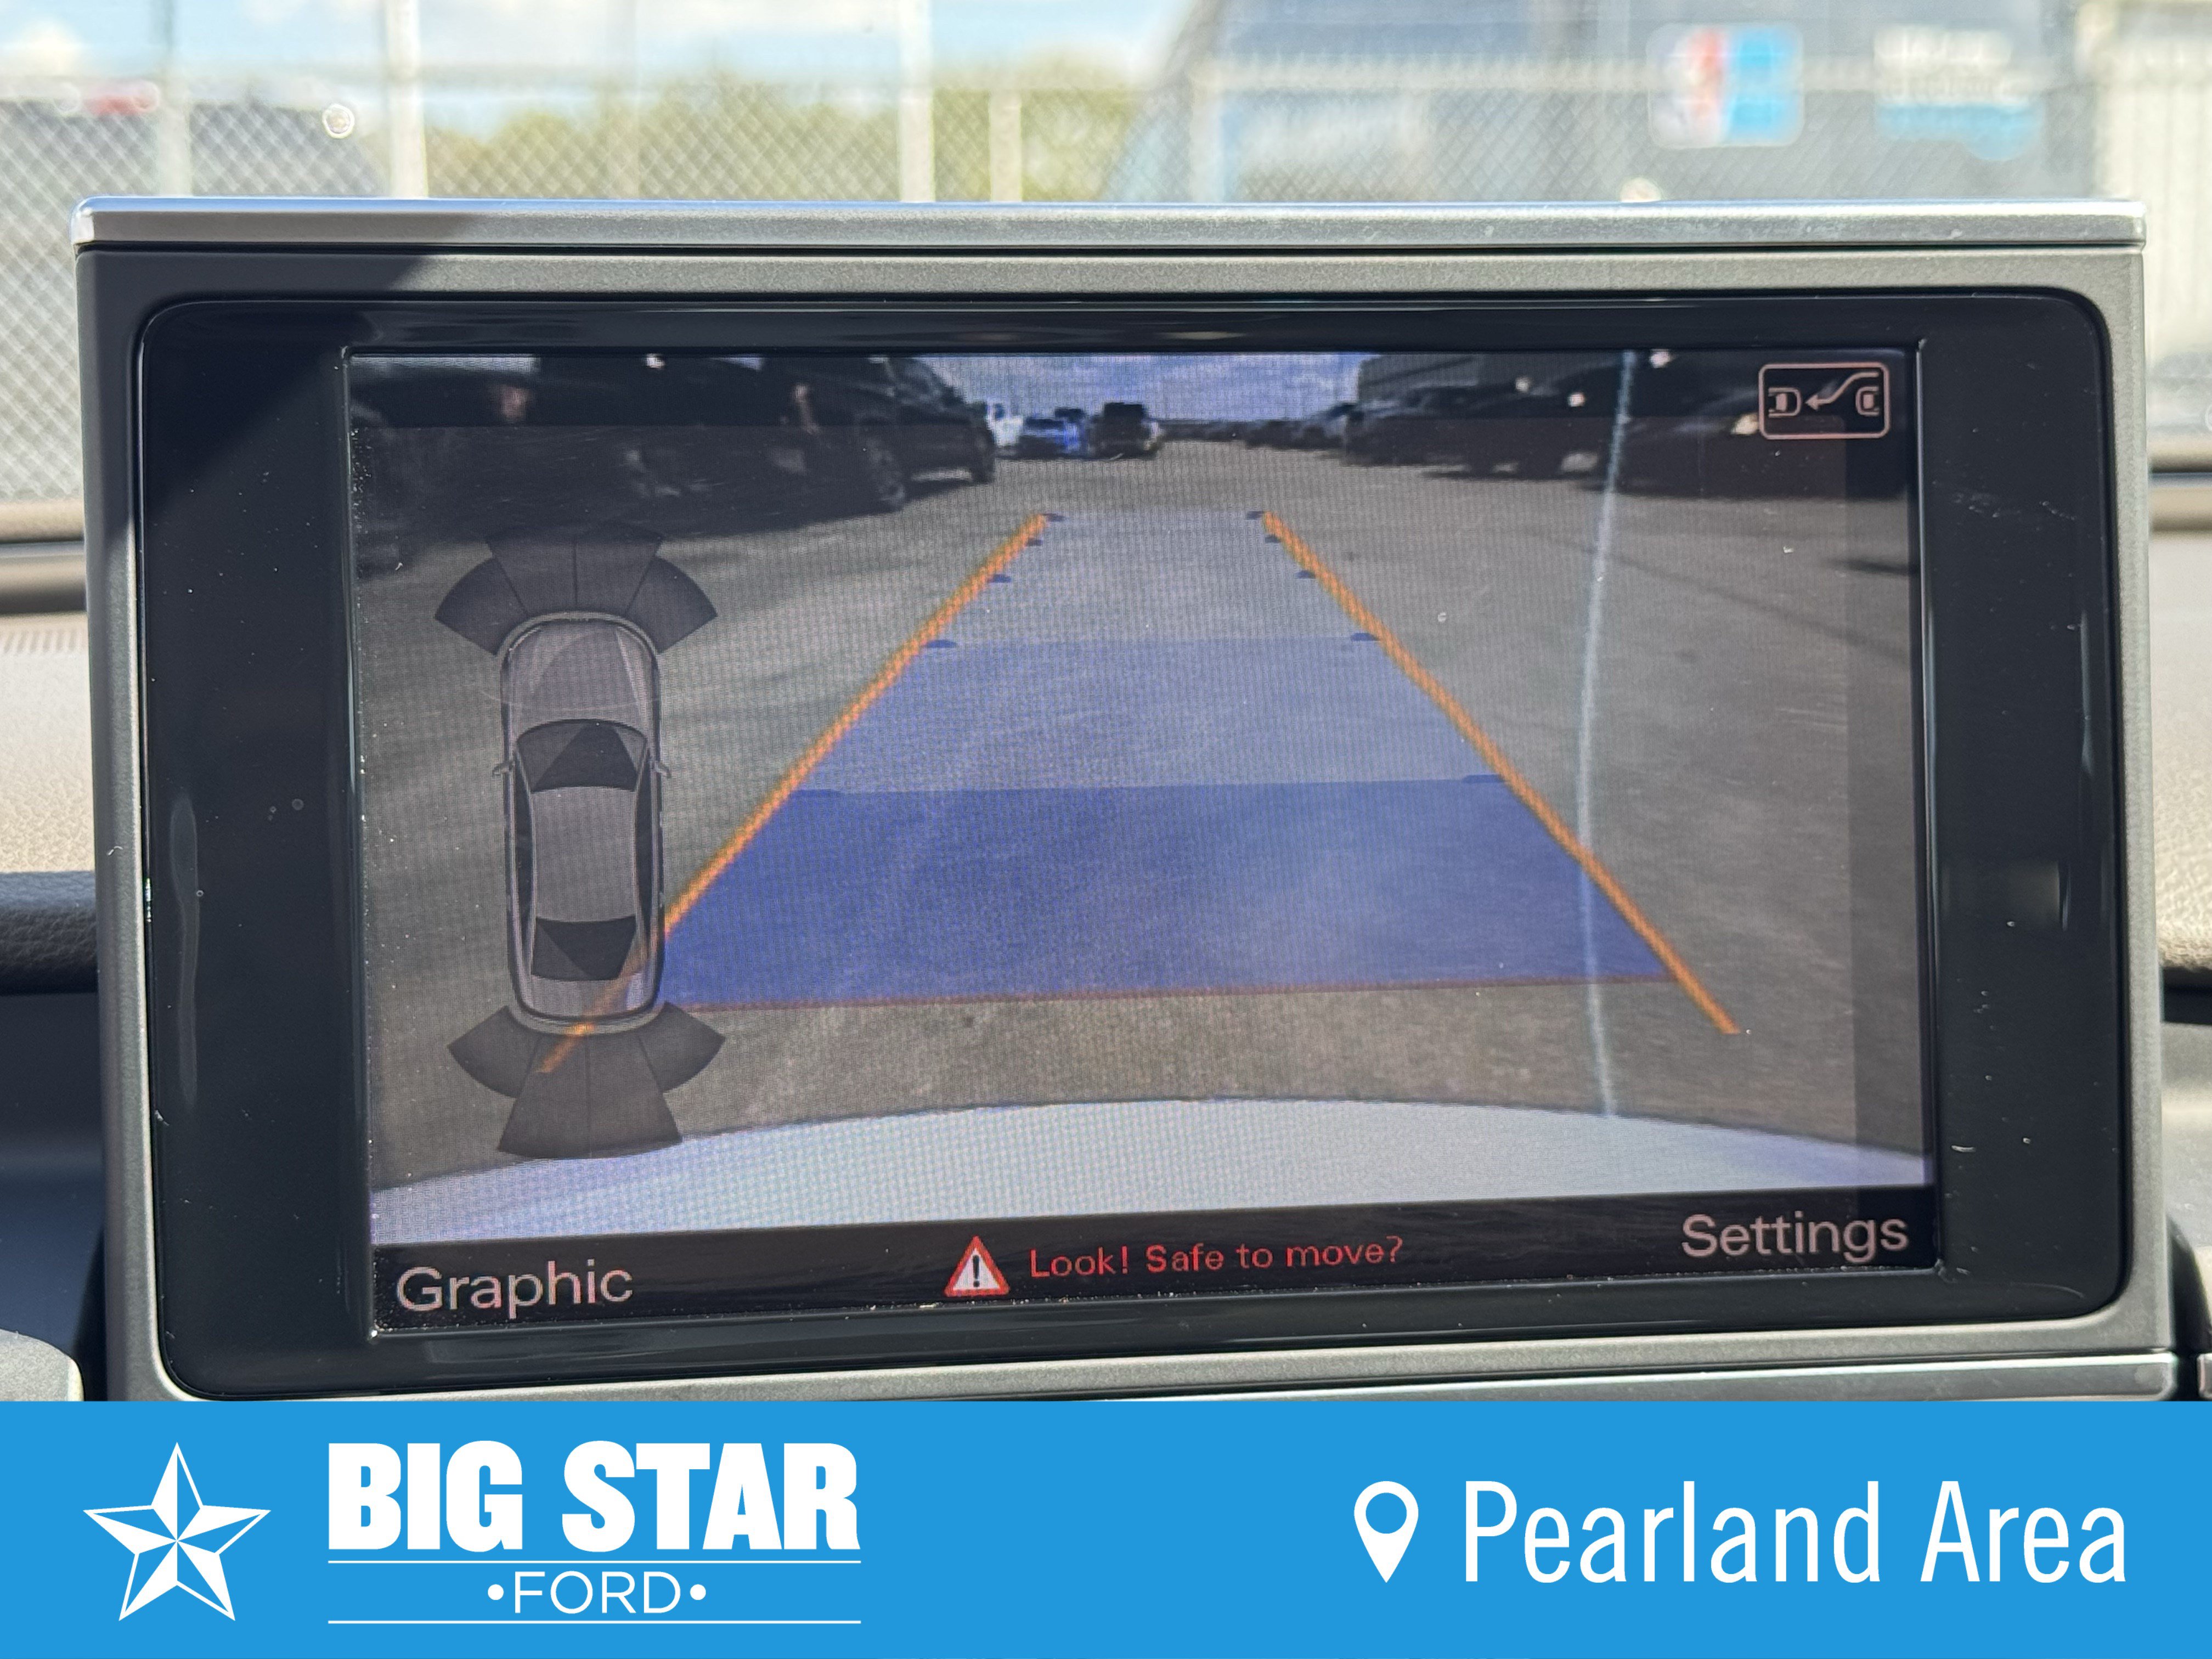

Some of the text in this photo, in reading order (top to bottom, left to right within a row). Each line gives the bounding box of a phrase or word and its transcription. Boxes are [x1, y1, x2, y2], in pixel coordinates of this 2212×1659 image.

[1030, 1235, 1403, 1278] Look! Safe to move?
[1681, 1210, 1909, 1263] Settings
[396, 1259, 633, 1319] Graphic
